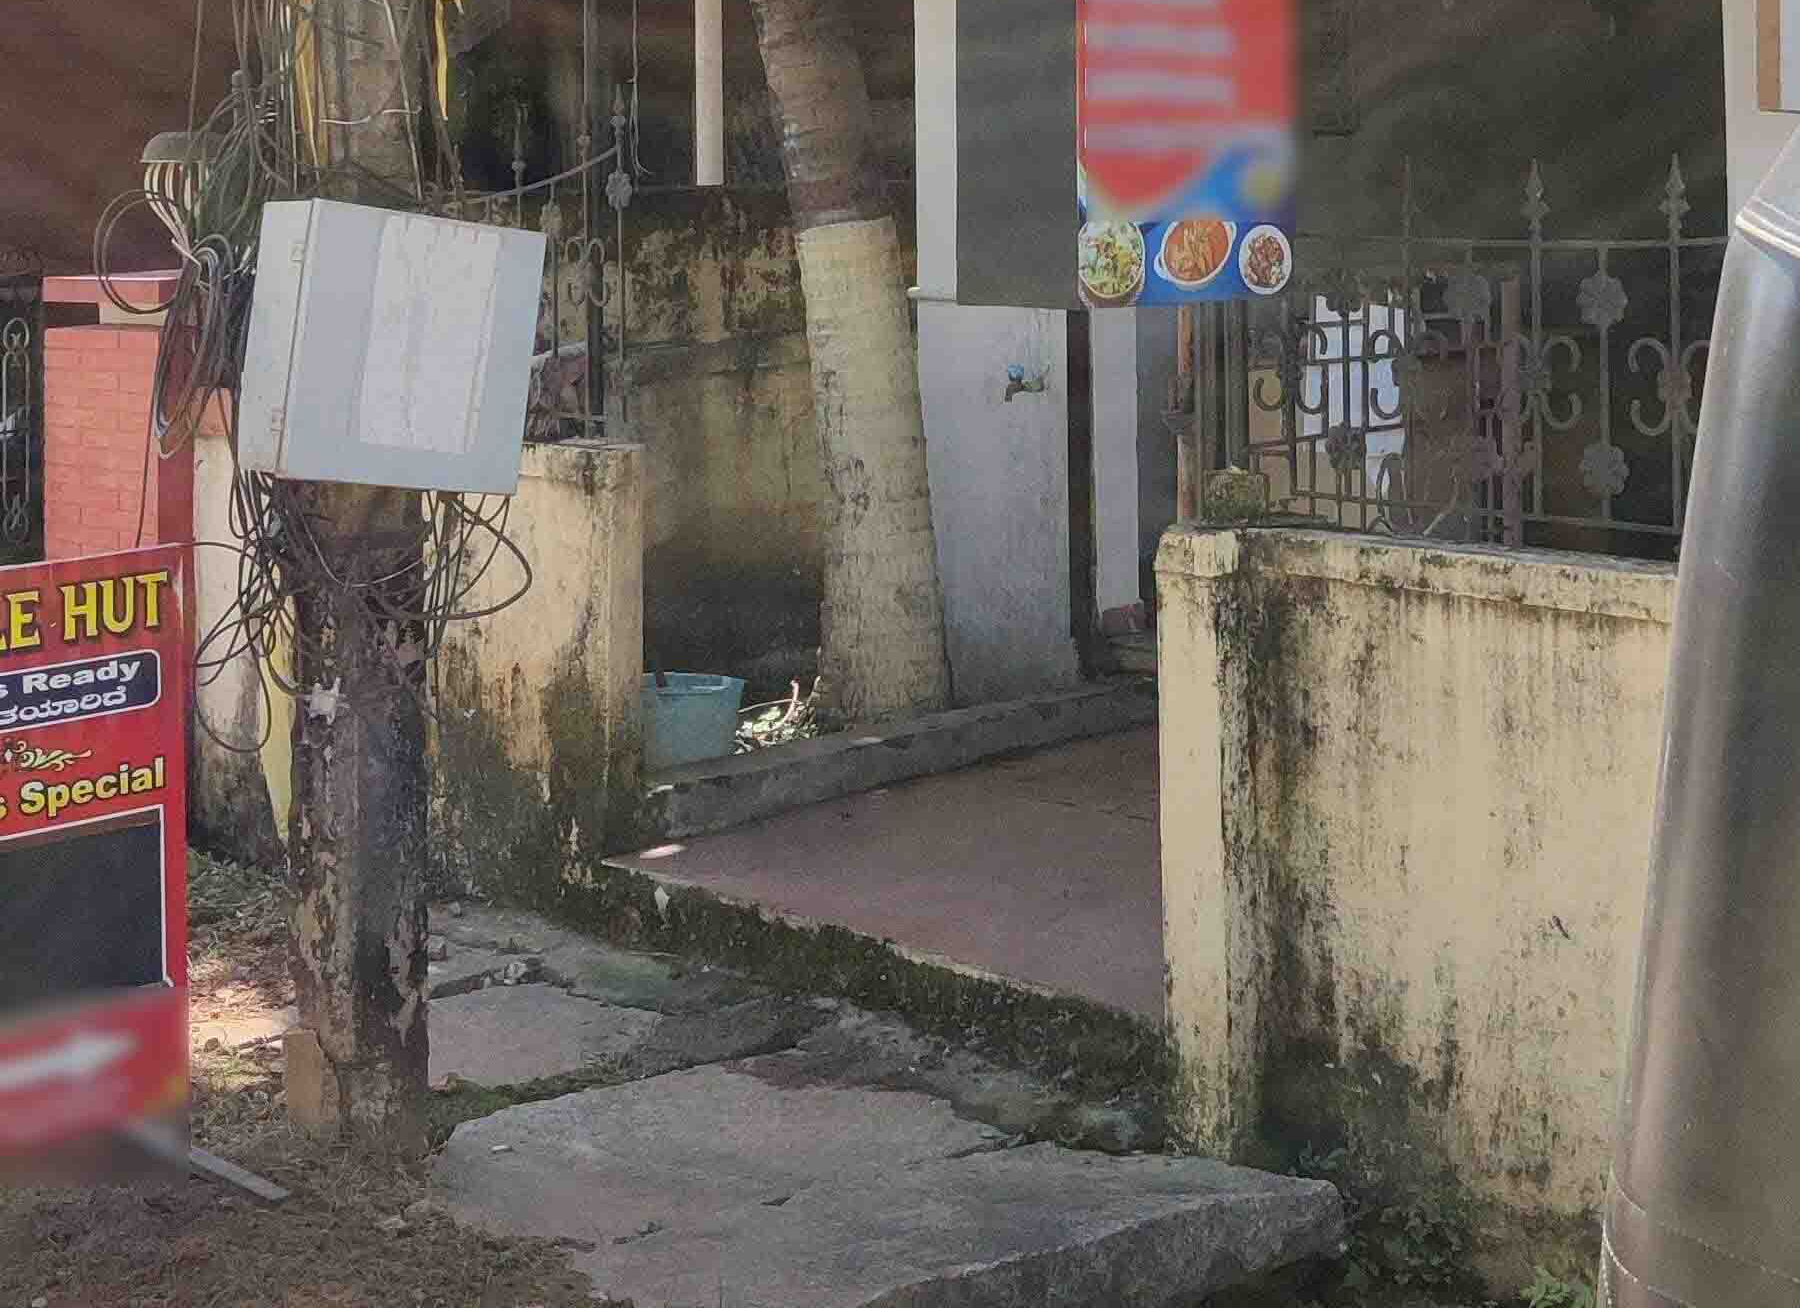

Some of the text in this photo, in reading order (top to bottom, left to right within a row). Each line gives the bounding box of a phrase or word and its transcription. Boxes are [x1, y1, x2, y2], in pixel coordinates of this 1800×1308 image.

[60, 571, 168, 641] HUT
[23, 660, 141, 694] Ready
[20, 756, 165, 817] Special
